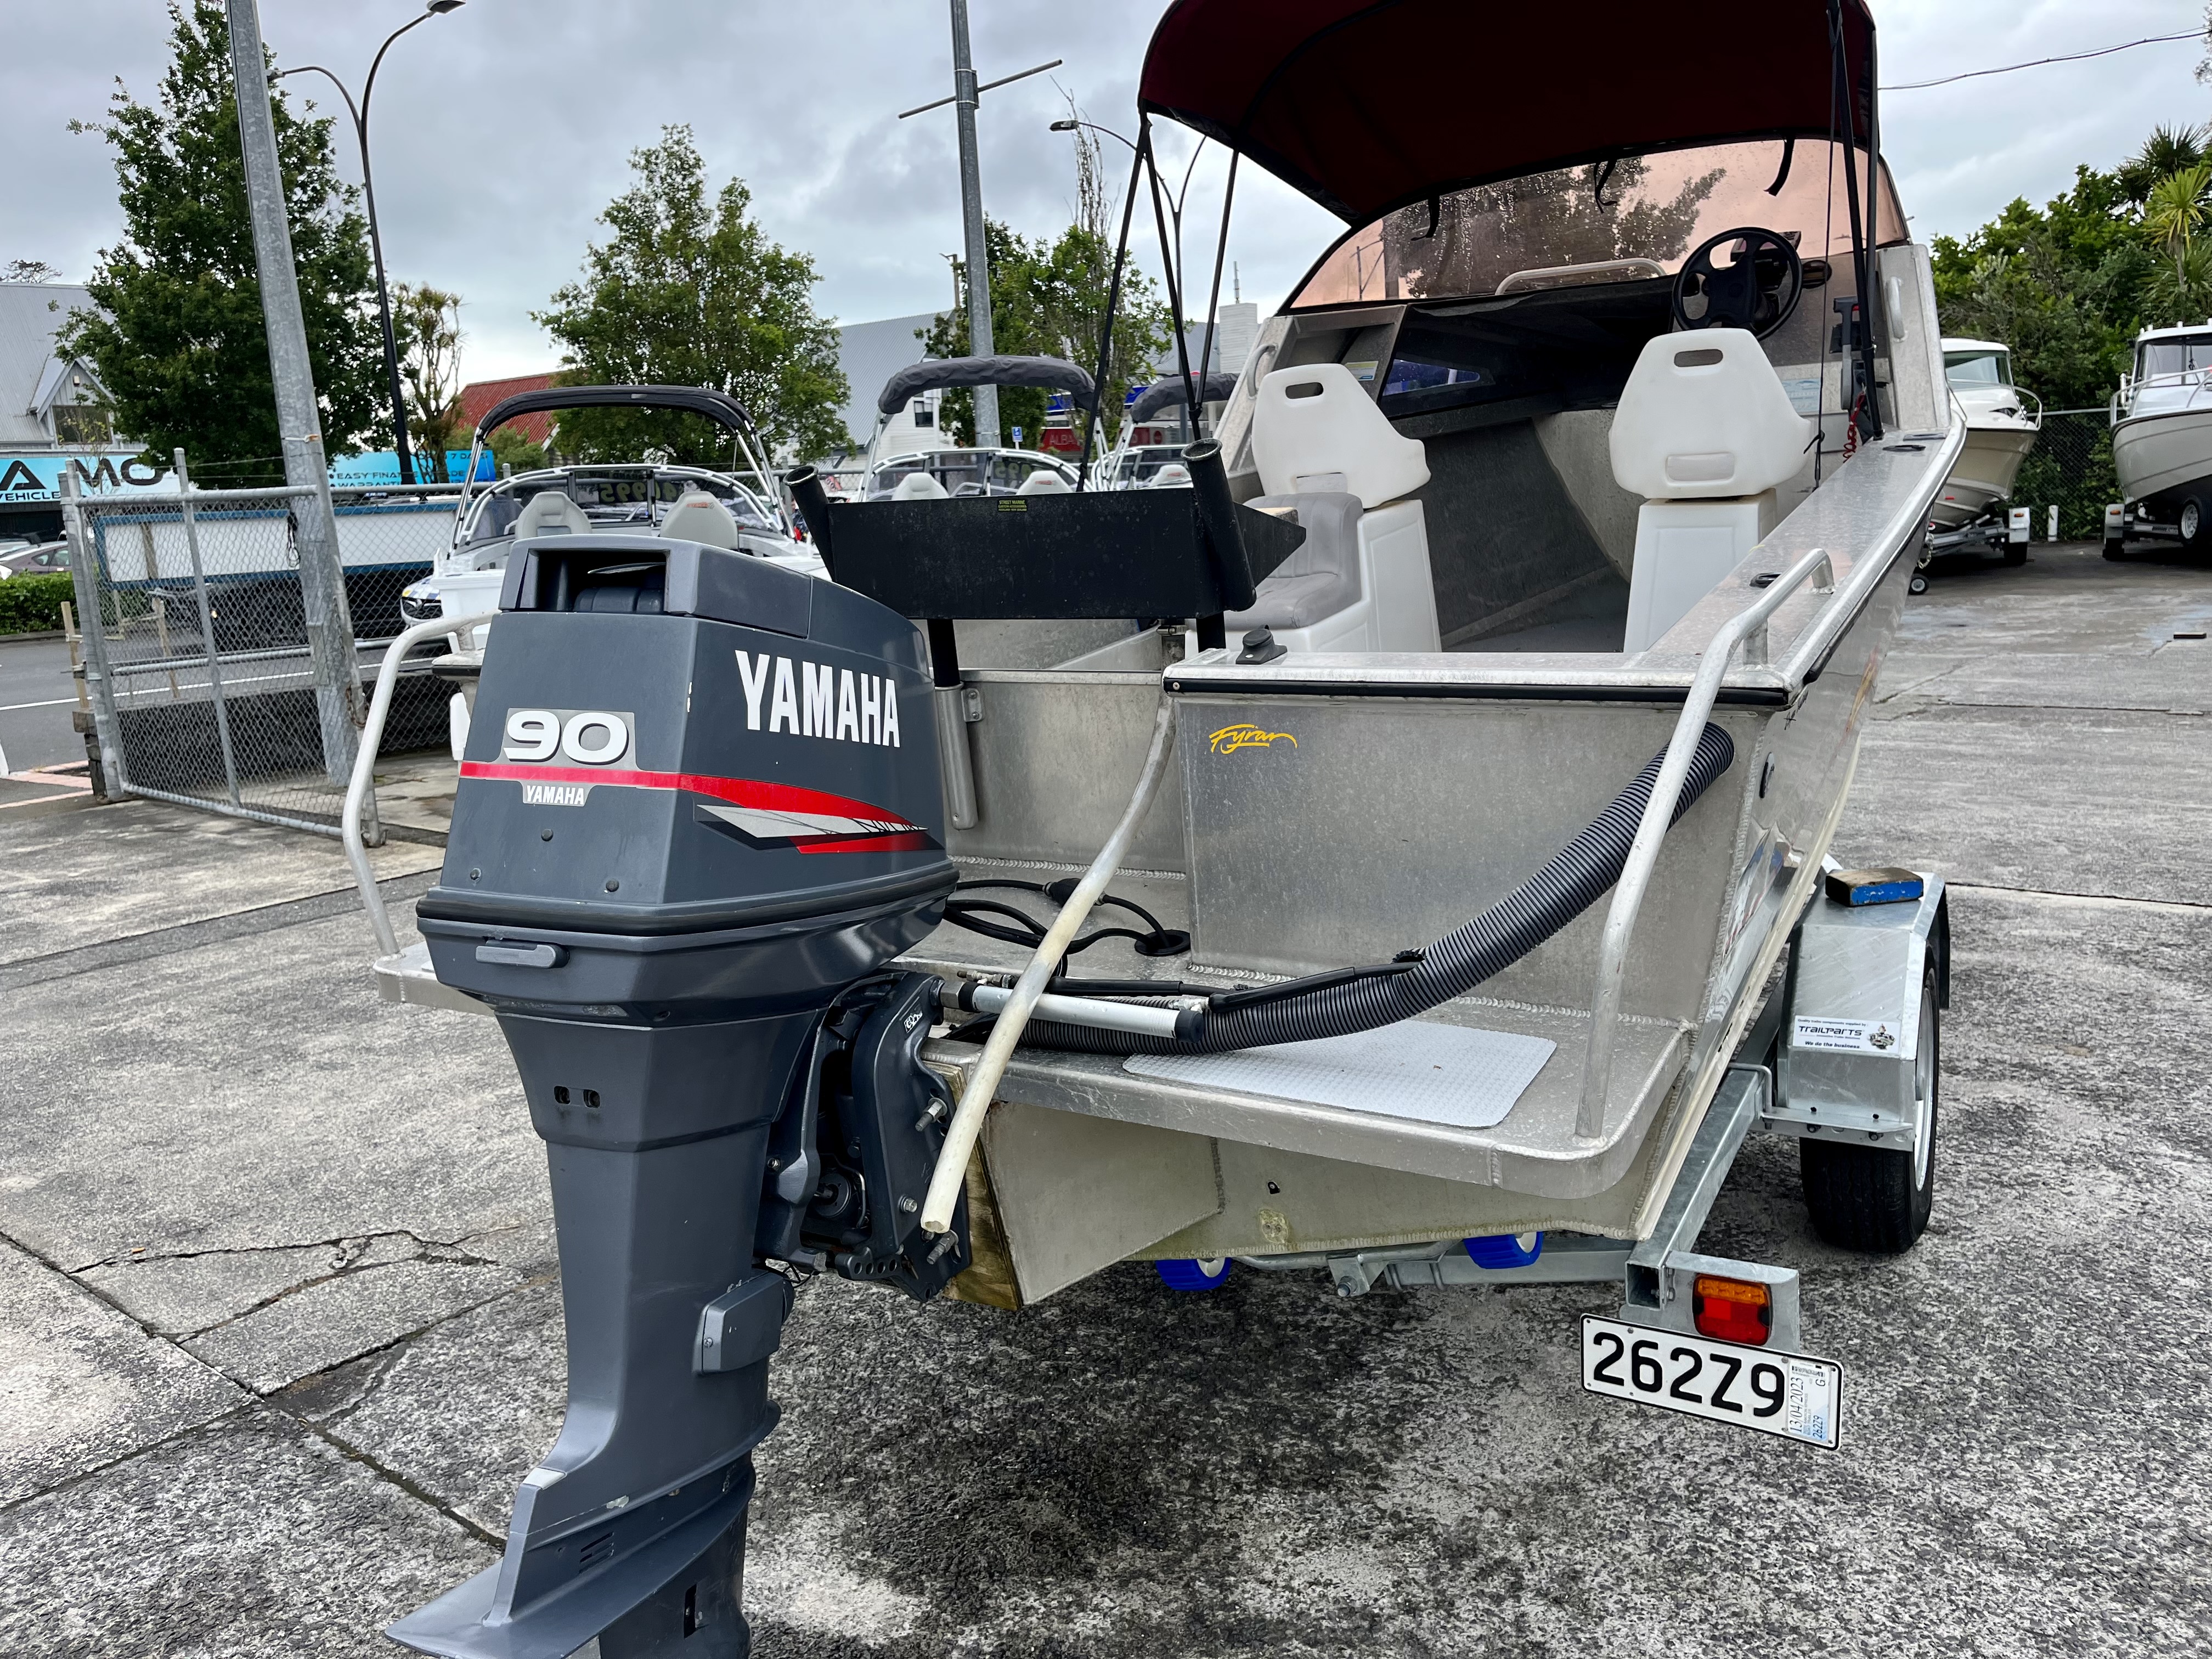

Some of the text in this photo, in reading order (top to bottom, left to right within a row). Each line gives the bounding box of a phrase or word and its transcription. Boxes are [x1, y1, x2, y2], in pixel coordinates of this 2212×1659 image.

[735, 650, 900, 748] YAMAHA
[504, 710, 629, 765] 90
[1209, 724, 1298, 754] Fyran
[527, 785, 584, 805] YAMAHA
[1594, 1331, 1785, 1417] 262Z9
[1790, 1377, 1803, 1432] 13/04/2023
[1813, 1415, 1823, 1438] 262Z9
